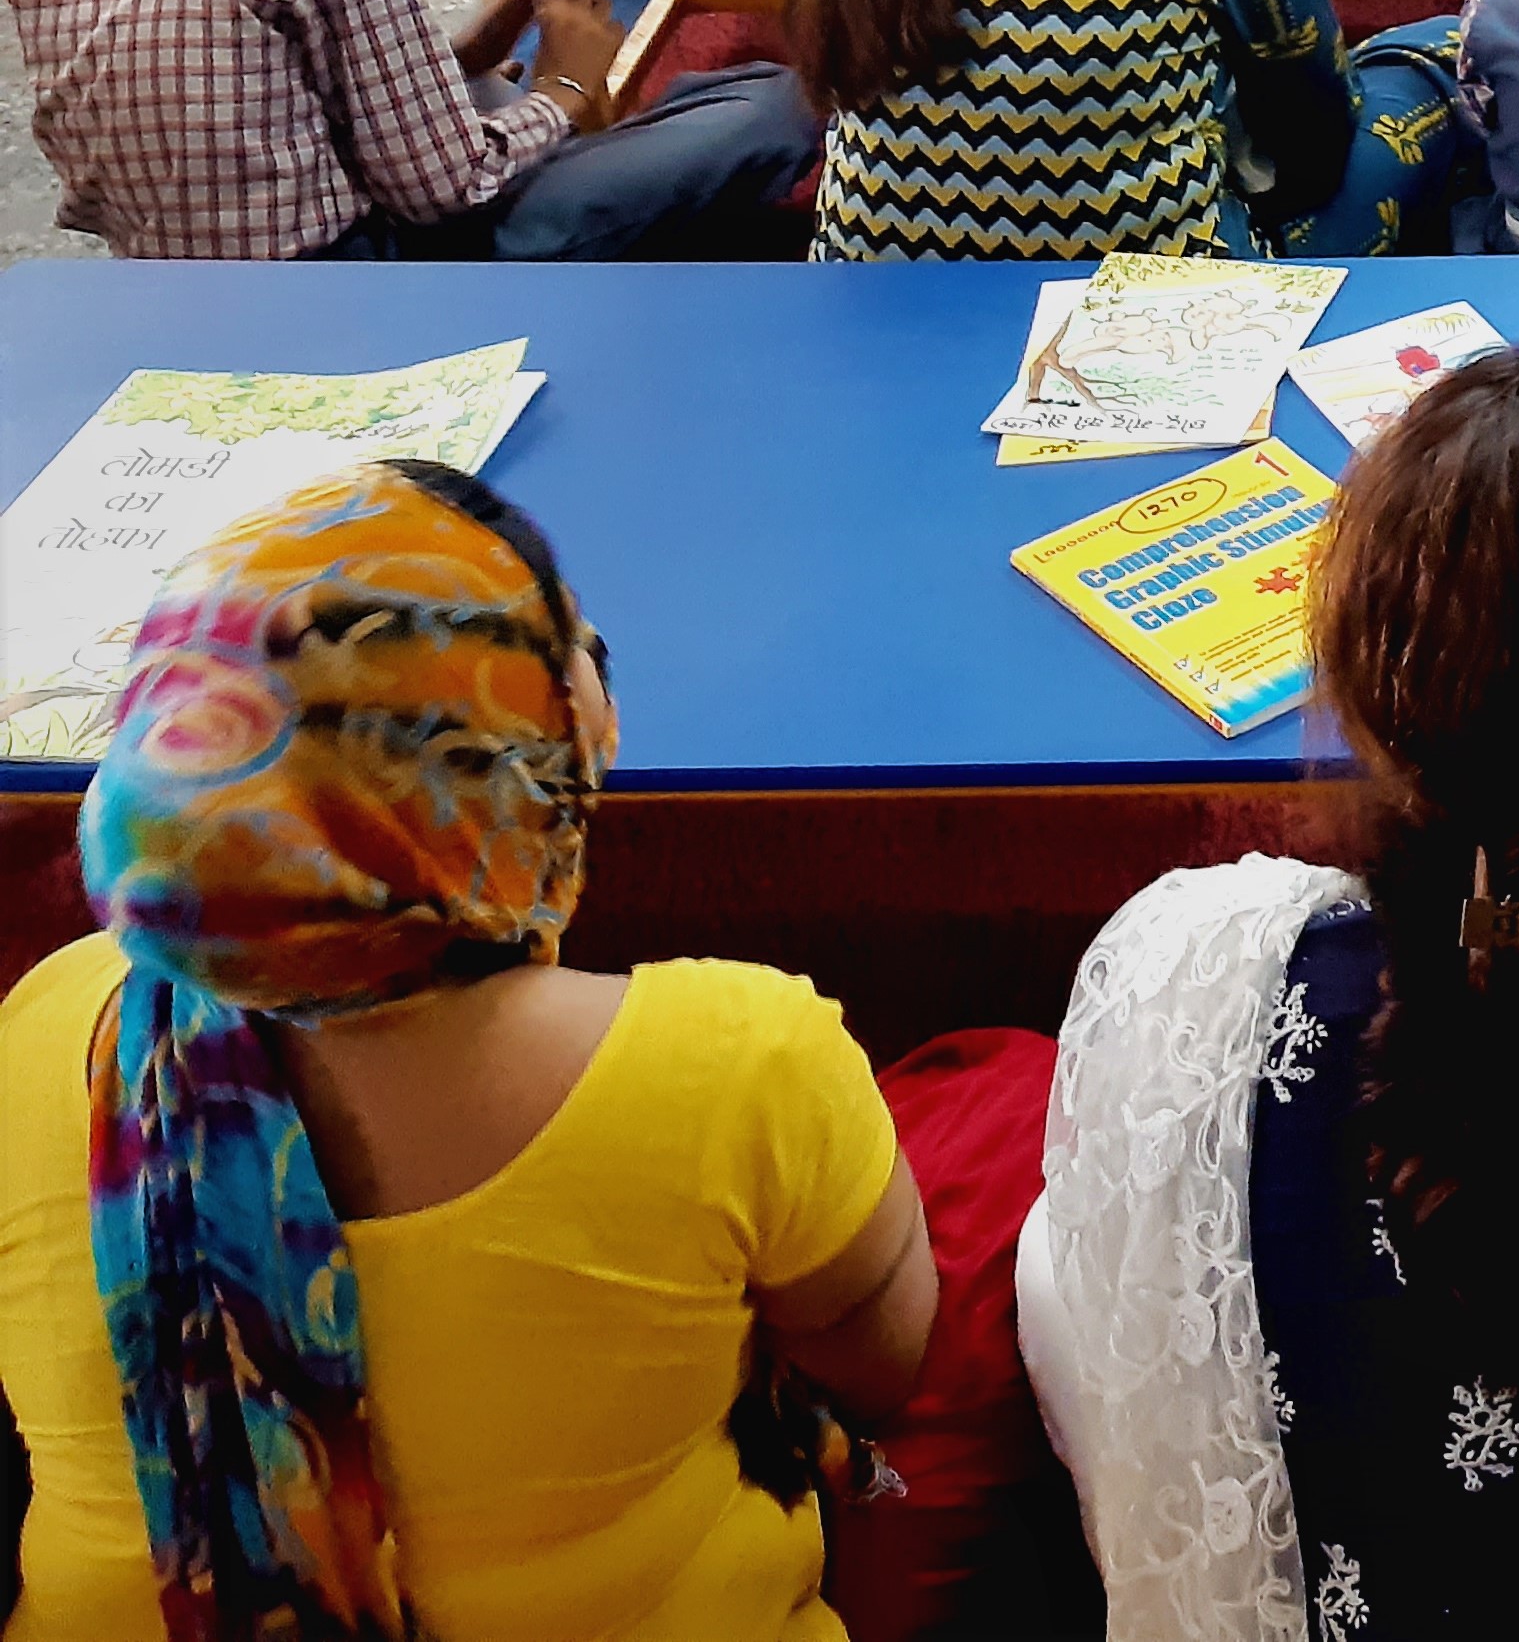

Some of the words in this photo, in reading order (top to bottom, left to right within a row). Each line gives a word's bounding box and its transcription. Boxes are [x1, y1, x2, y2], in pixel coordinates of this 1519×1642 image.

[1255, 450, 1290, 477] 1
[105, 491, 168, 513] का
[1138, 490, 1197, 520] 1270
[1077, 485, 1306, 590] Comprehension
[1103, 551, 1225, 611] Graphic
[1131, 587, 1219, 633] Cloze
